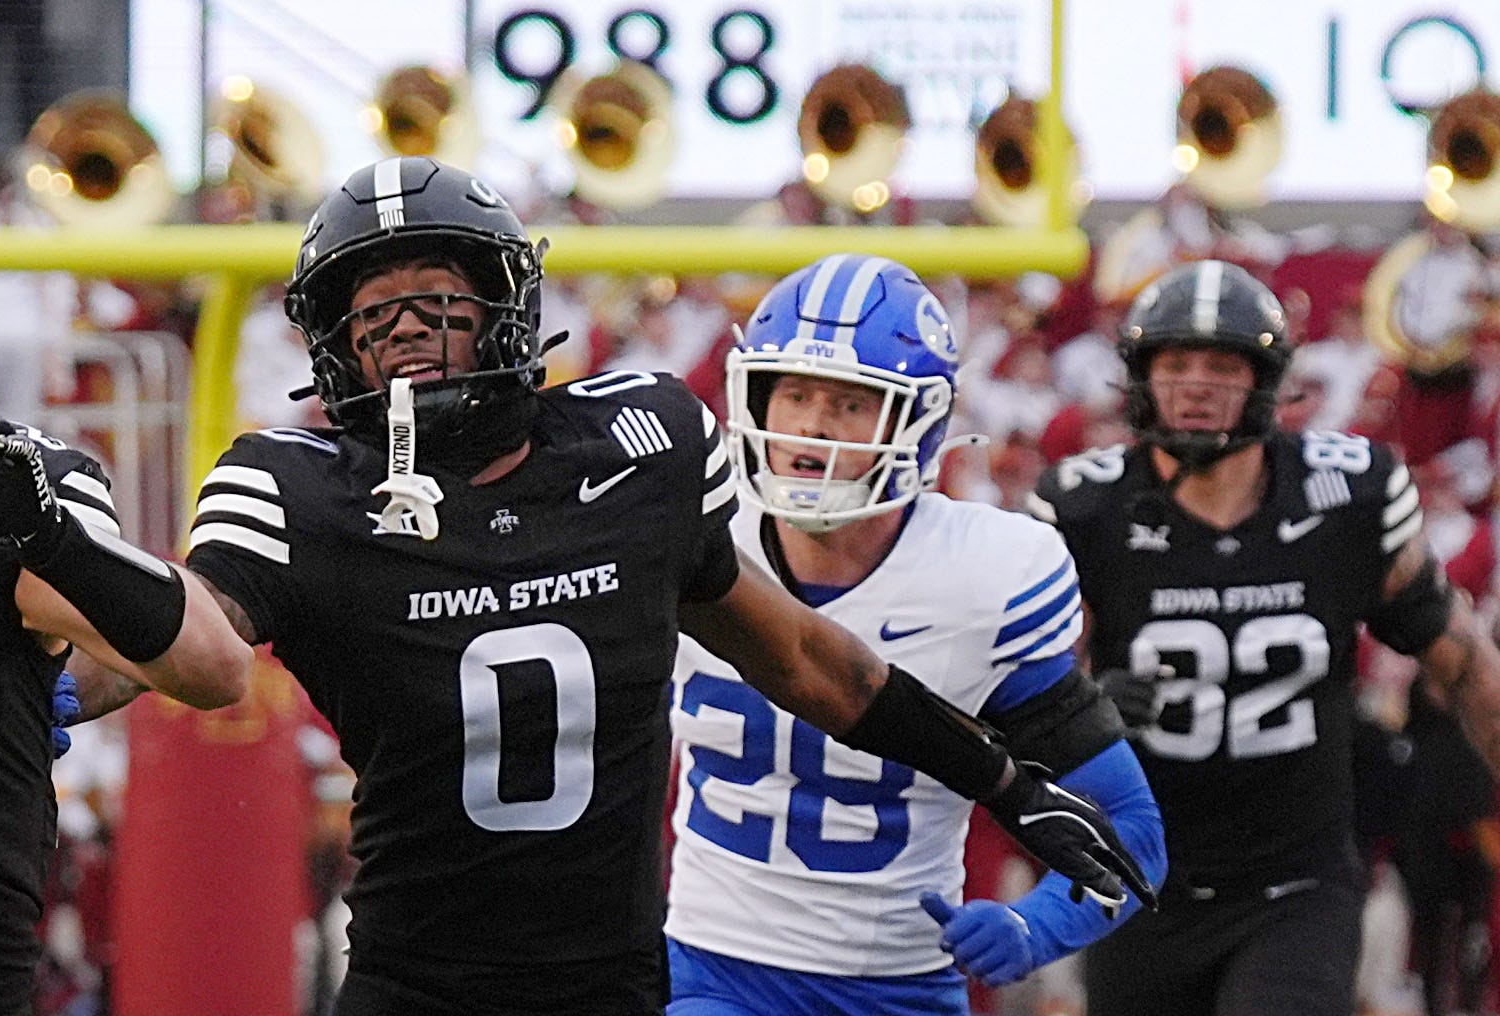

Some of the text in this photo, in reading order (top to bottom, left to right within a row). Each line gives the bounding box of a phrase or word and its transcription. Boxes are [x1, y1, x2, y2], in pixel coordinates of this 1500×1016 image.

[804, 343, 835, 358] BYU
[393, 425, 410, 475] NXTRND
[408, 563, 620, 621] IOWA STATE
[1151, 580, 1306, 615] IOWA STATE
[1129, 613, 1331, 761] 82
[459, 622, 597, 832] 0
[686, 670, 916, 874] 28
